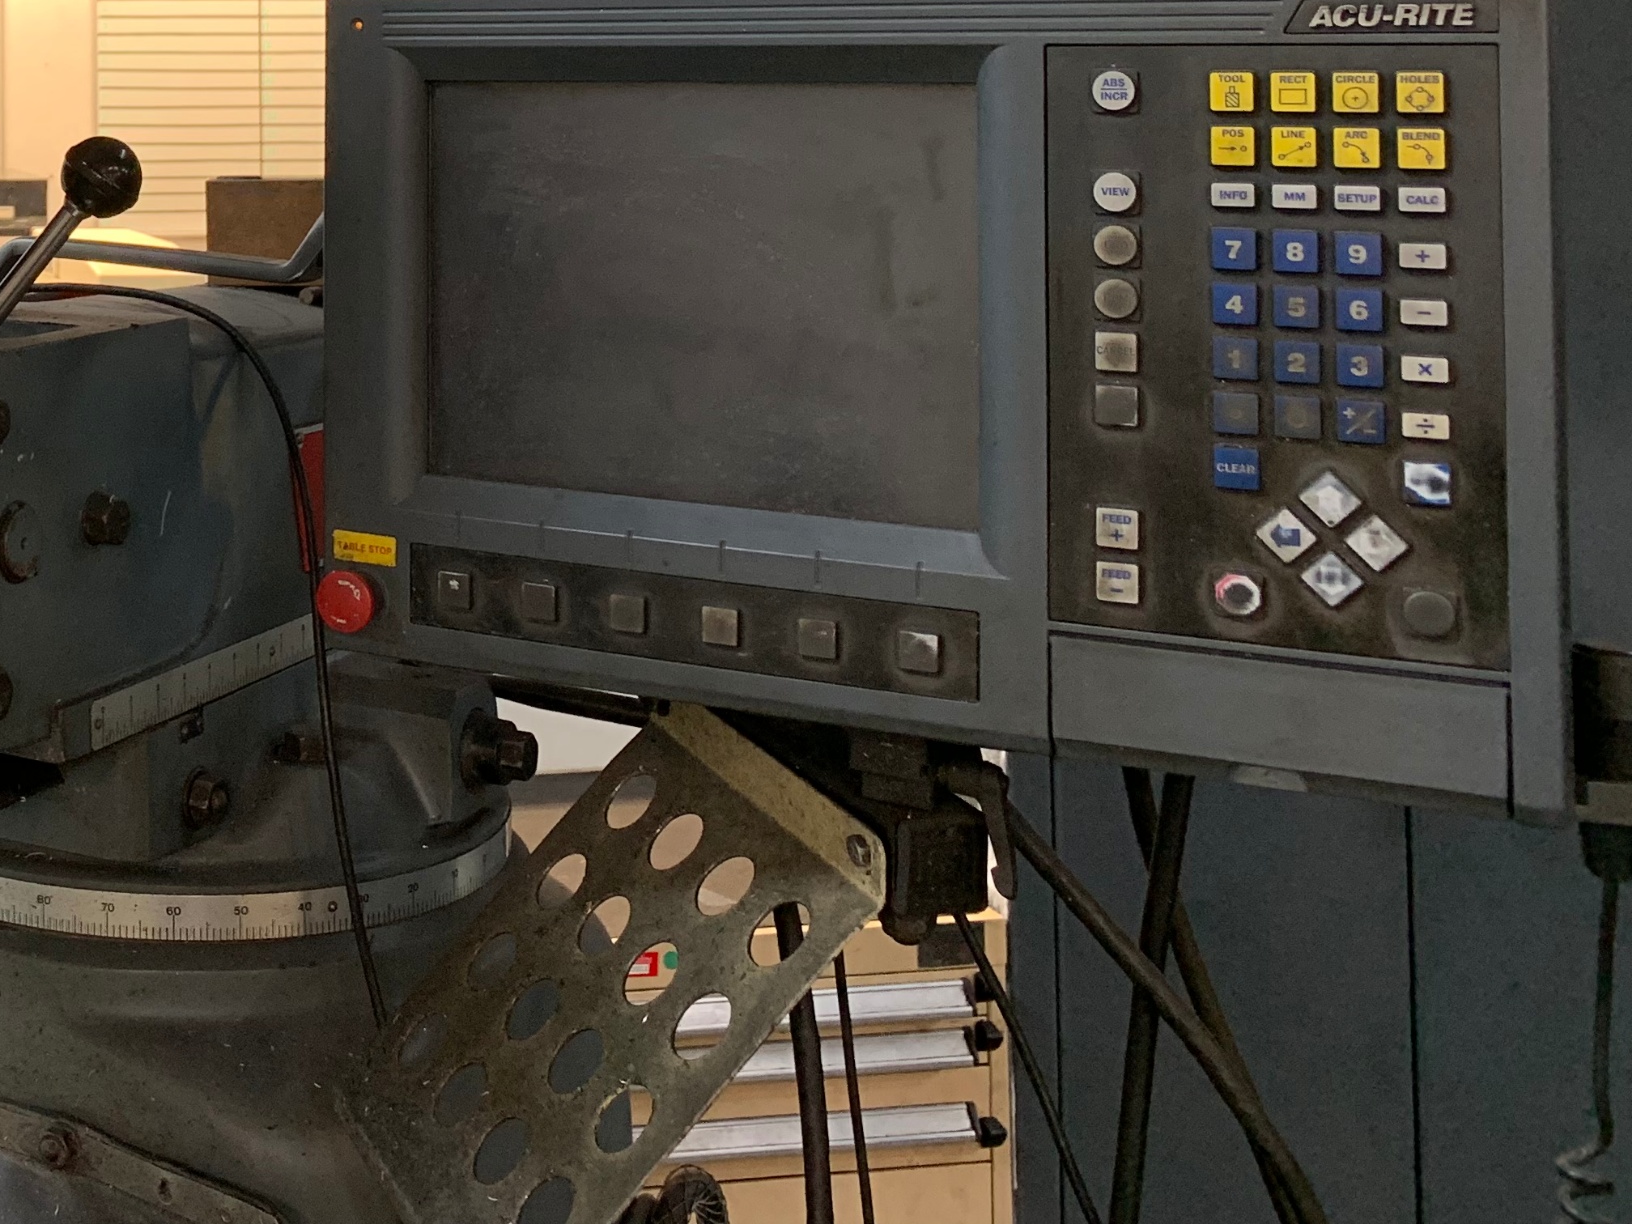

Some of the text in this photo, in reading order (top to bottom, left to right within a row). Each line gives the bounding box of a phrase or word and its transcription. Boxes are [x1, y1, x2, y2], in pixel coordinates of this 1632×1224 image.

[1308, 3, 1475, 29] ACU-RITE
[1102, 79, 1125, 87] ABS
[1279, 76, 1308, 84] RECT
[1335, 76, 1375, 84] CIRCLE
[1400, 76, 1440, 84] HOLES
[1101, 92, 1128, 100] INCR
[1345, 131, 1368, 139] ARC
[1402, 132, 1440, 140] BLEND
[1101, 188, 1130, 196] VIEW
[1219, 191, 1247, 200] INFO
[1284, 192, 1306, 201] MM
[1337, 194, 1376, 203] SETUP
[1406, 195, 1439, 205] CALC
[1225, 240, 1242, 259] 7
[1286, 242, 1304, 262] 8
[1347, 244, 1367, 264] 9
[1225, 295, 1243, 313] 4
[1287, 297, 1306, 317] 5
[1349, 300, 1368, 320] 6
[1228, 350, 1241, 369] 1
[1287, 353, 1306, 372] 2
[1350, 356, 1368, 376] 3
[1217, 463, 1255, 474] CLEAR
[1102, 513, 1132, 525] FEED
[337, 541, 392, 554] TABLE STOP
[1101, 569, 1132, 580] FEED
[37, 895, 51, 904] 80
[101, 903, 115, 912] 70
[166, 905, 181, 916] 60
[234, 906, 249, 915] 50
[298, 901, 312, 911] 40
[408, 882, 419, 893] 20
